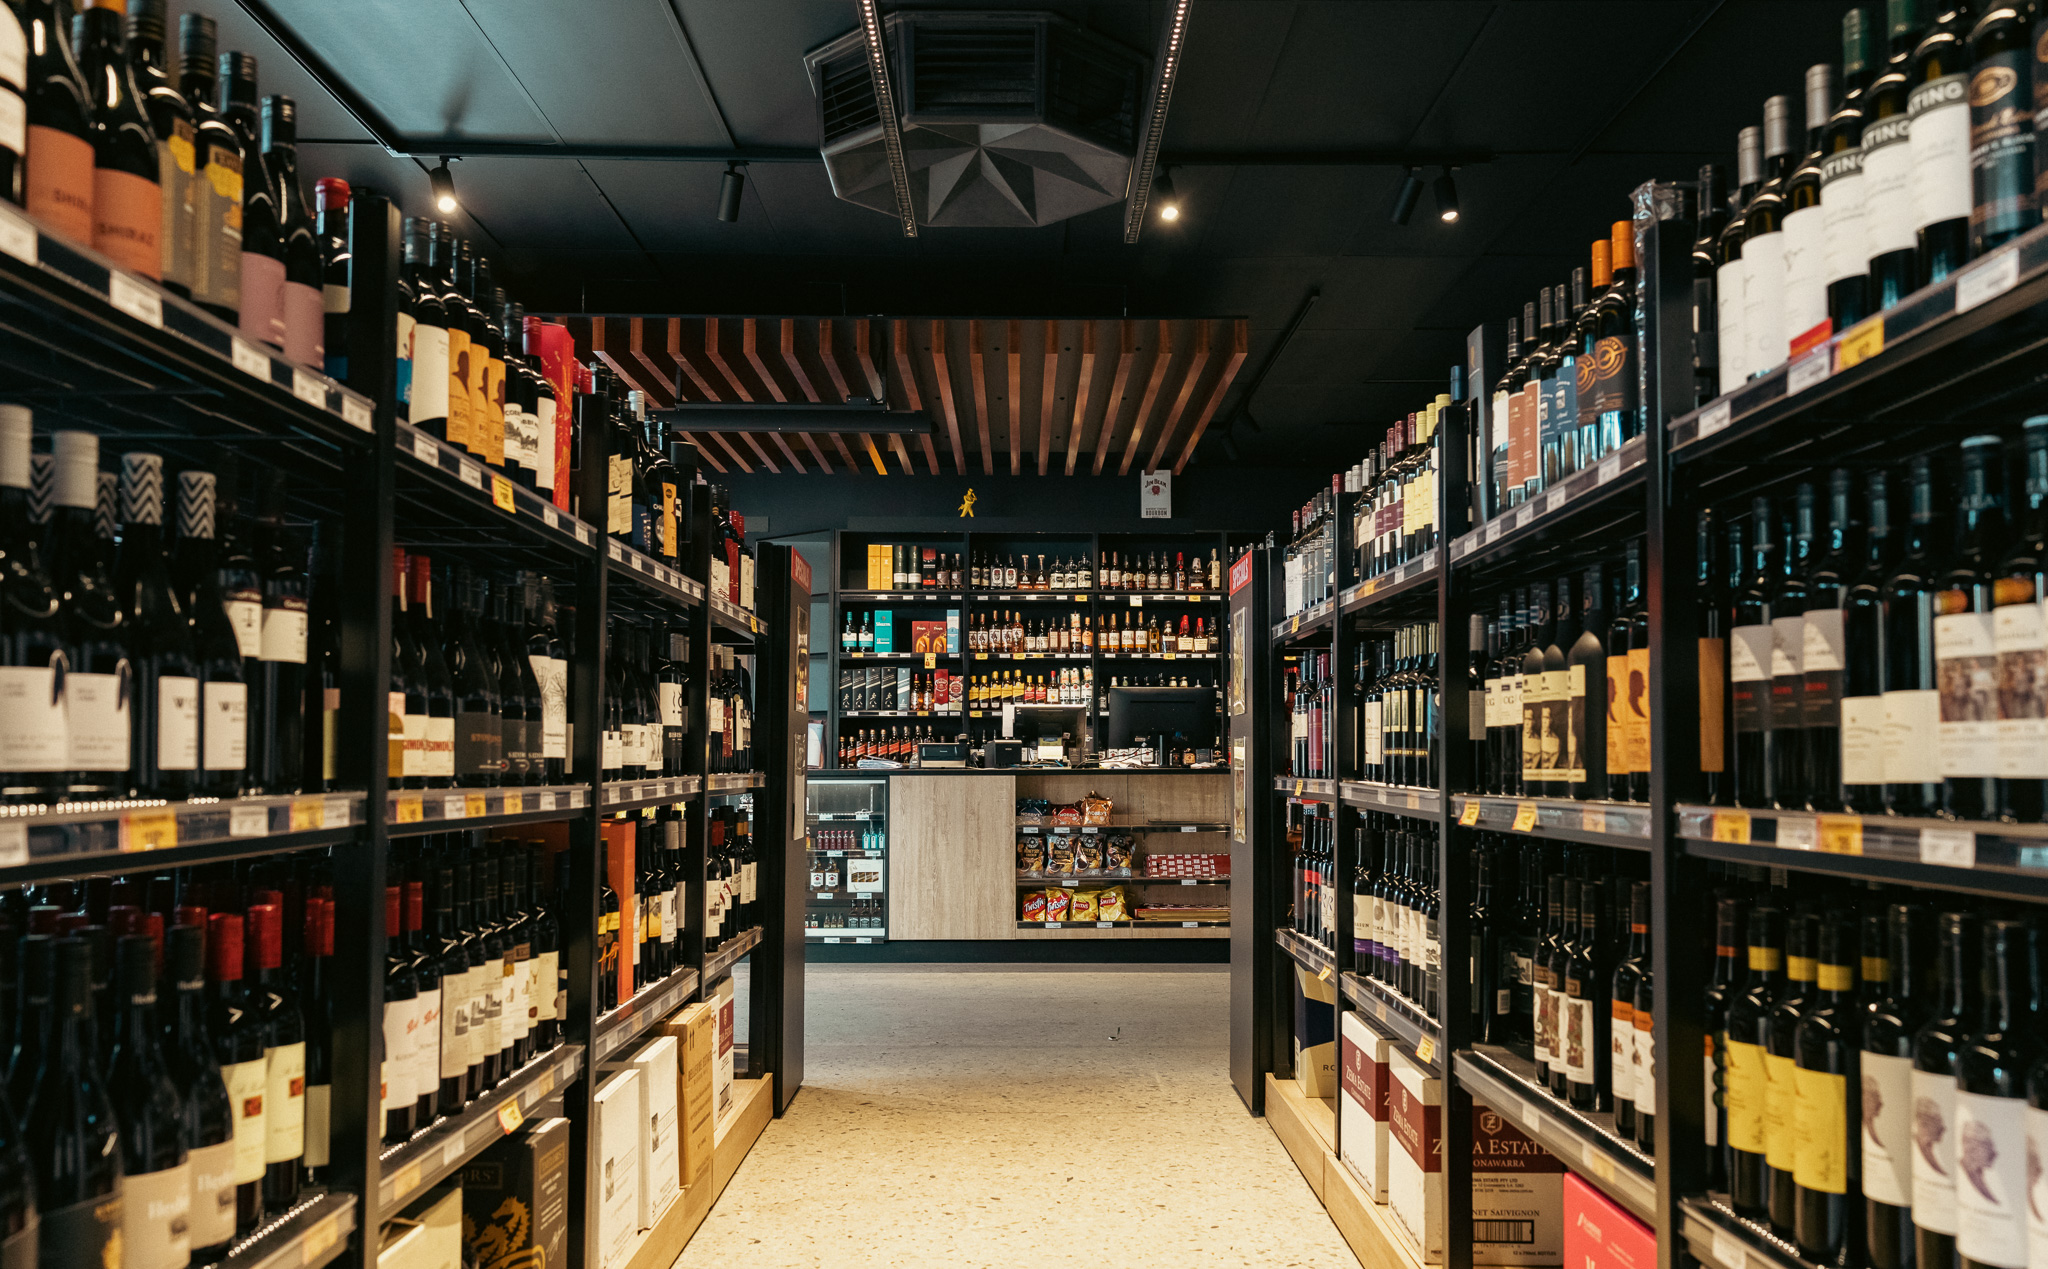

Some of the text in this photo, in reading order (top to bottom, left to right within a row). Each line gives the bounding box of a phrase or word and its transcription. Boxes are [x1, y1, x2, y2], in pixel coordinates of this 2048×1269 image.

[1145, 479, 1167, 488] JIM BEAM
[1232, 557, 1249, 591] SPECIALS
[1346, 1065, 1357, 1088] ZEMA
[1357, 1075, 1371, 1101] ESTATE
[1393, 1104, 1404, 1131] ZEMA
[1403, 1117, 1418, 1148] ESTATE
[1473, 1159, 1525, 1168] ONAWARRA
[1490, 1209, 1540, 1217] SAUVIGNON
